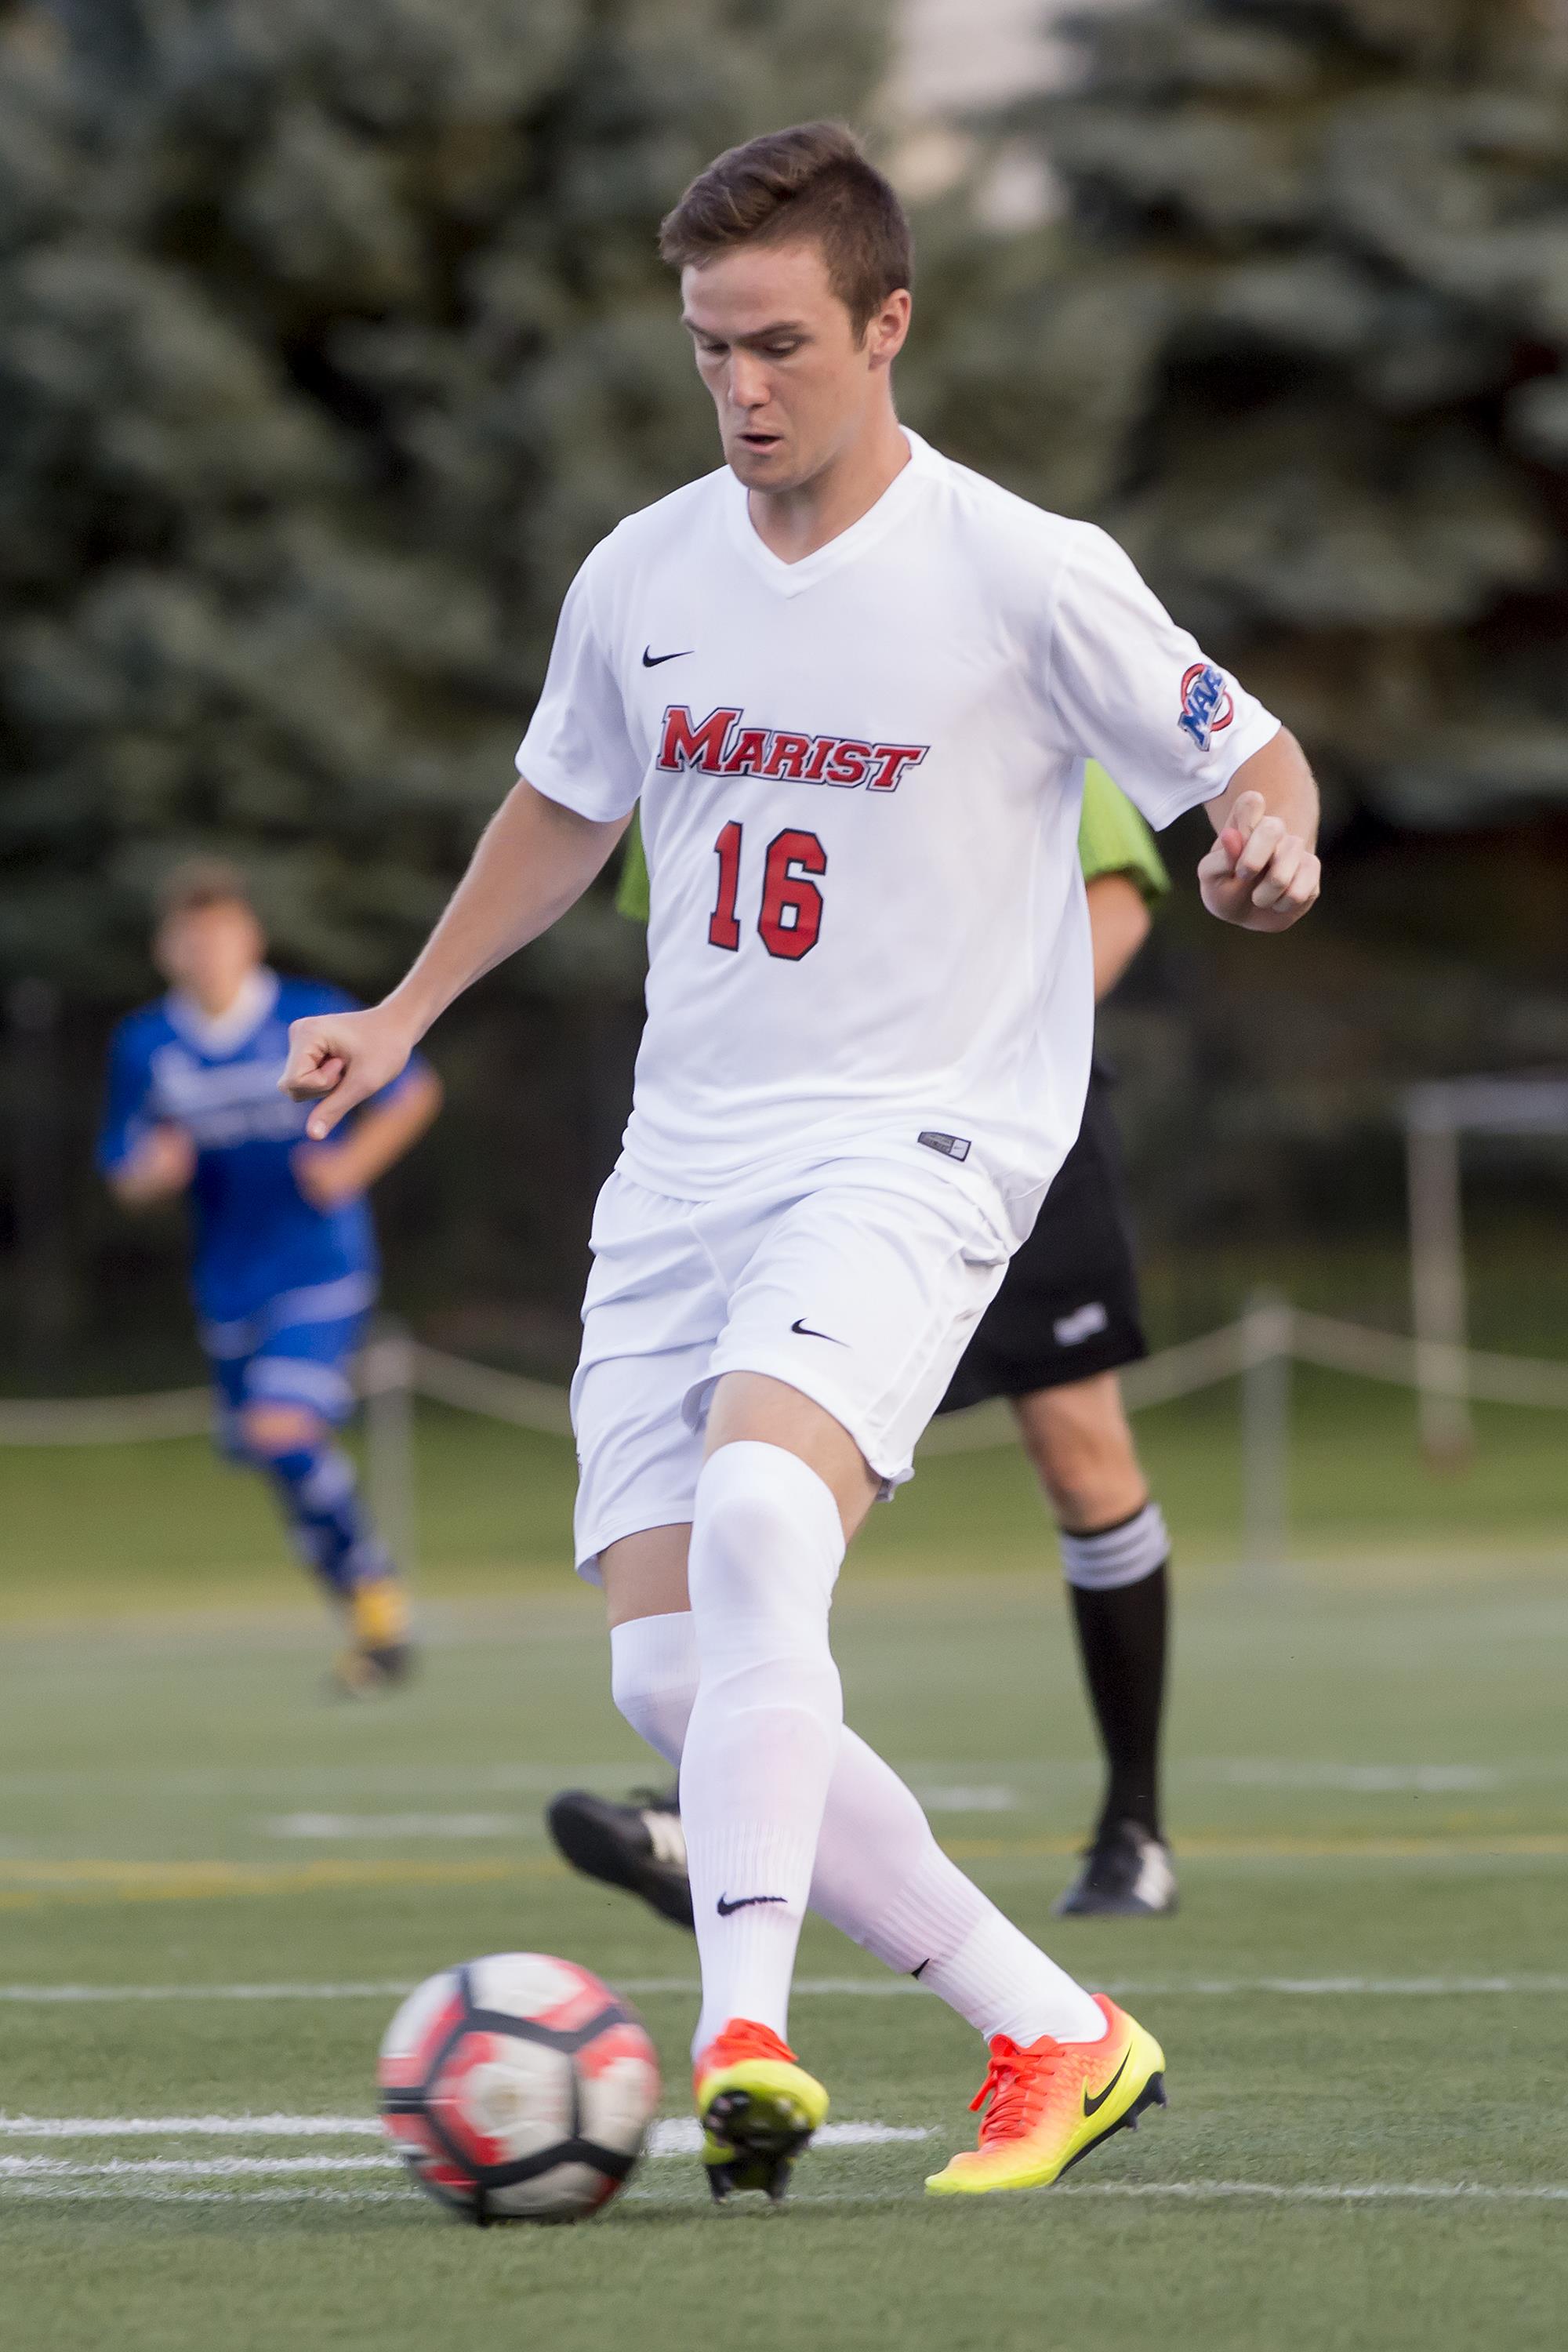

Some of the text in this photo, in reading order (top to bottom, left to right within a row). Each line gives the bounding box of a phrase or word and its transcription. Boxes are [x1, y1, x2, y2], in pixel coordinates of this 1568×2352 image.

[656, 705, 931, 792] MARIST
[1178, 665, 1225, 752] MAA
[708, 820, 827, 961] 16
